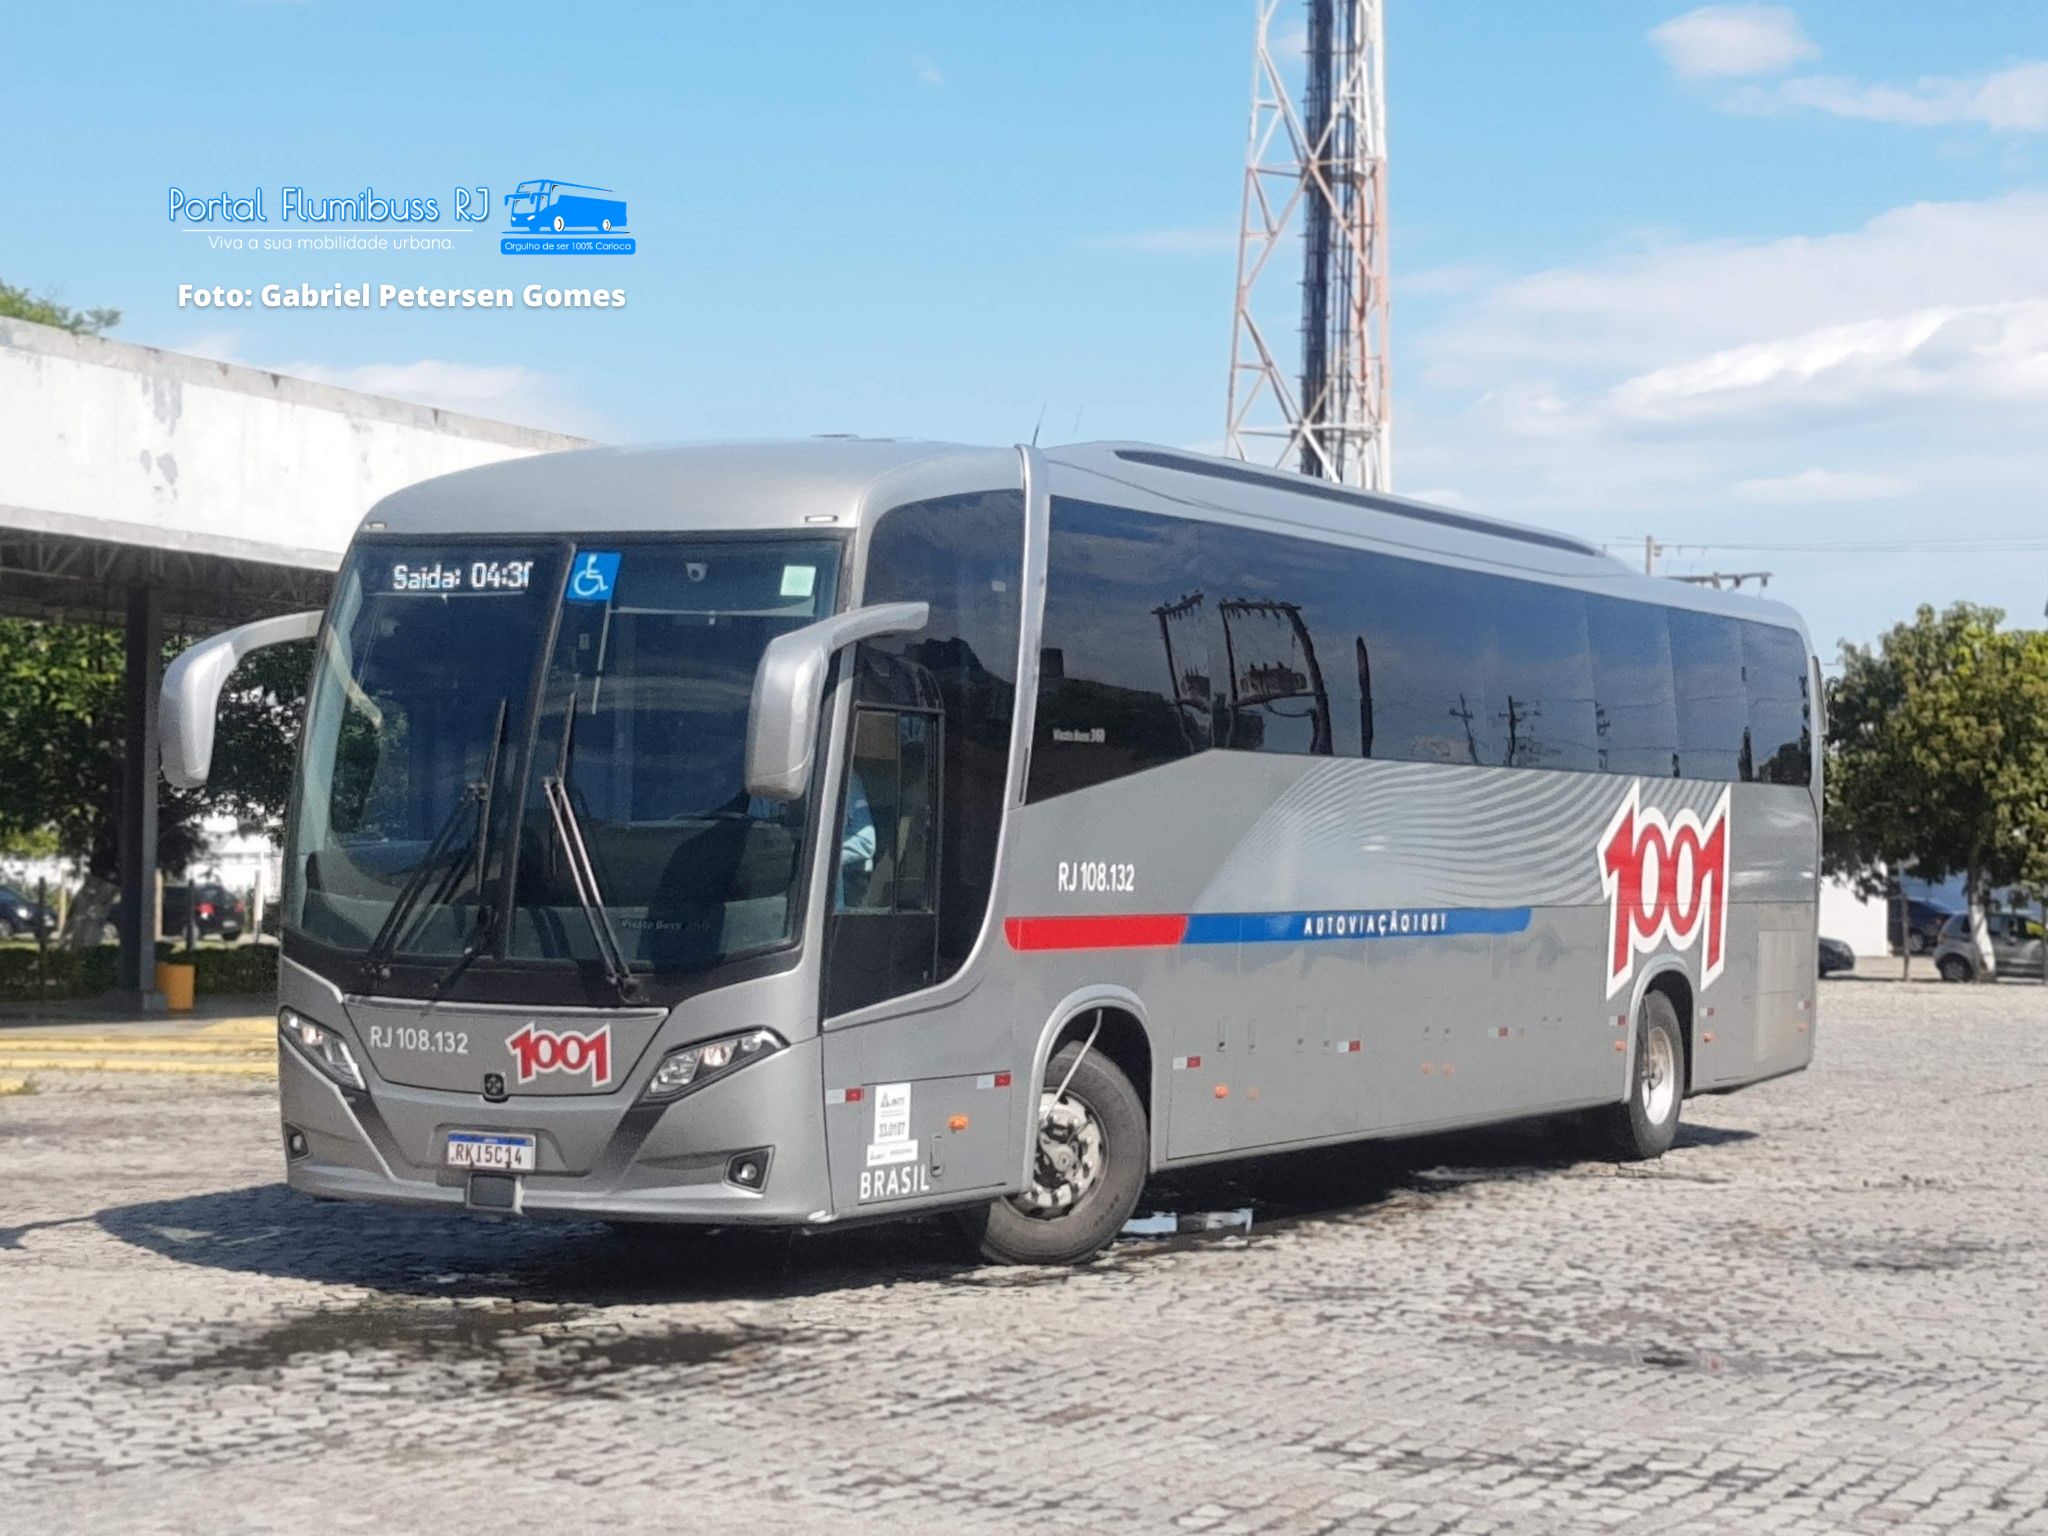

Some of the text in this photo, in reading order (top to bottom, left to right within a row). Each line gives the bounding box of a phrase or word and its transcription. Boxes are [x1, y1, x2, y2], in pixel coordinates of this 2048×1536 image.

[1058, 861, 1135, 892] RJ 108.132
[1597, 779, 1731, 1001] 1001
[370, 1025, 468, 1055] RJ 108.132
[505, 1020, 612, 1088] 1001
[860, 1163, 930, 1199] BRASIL
